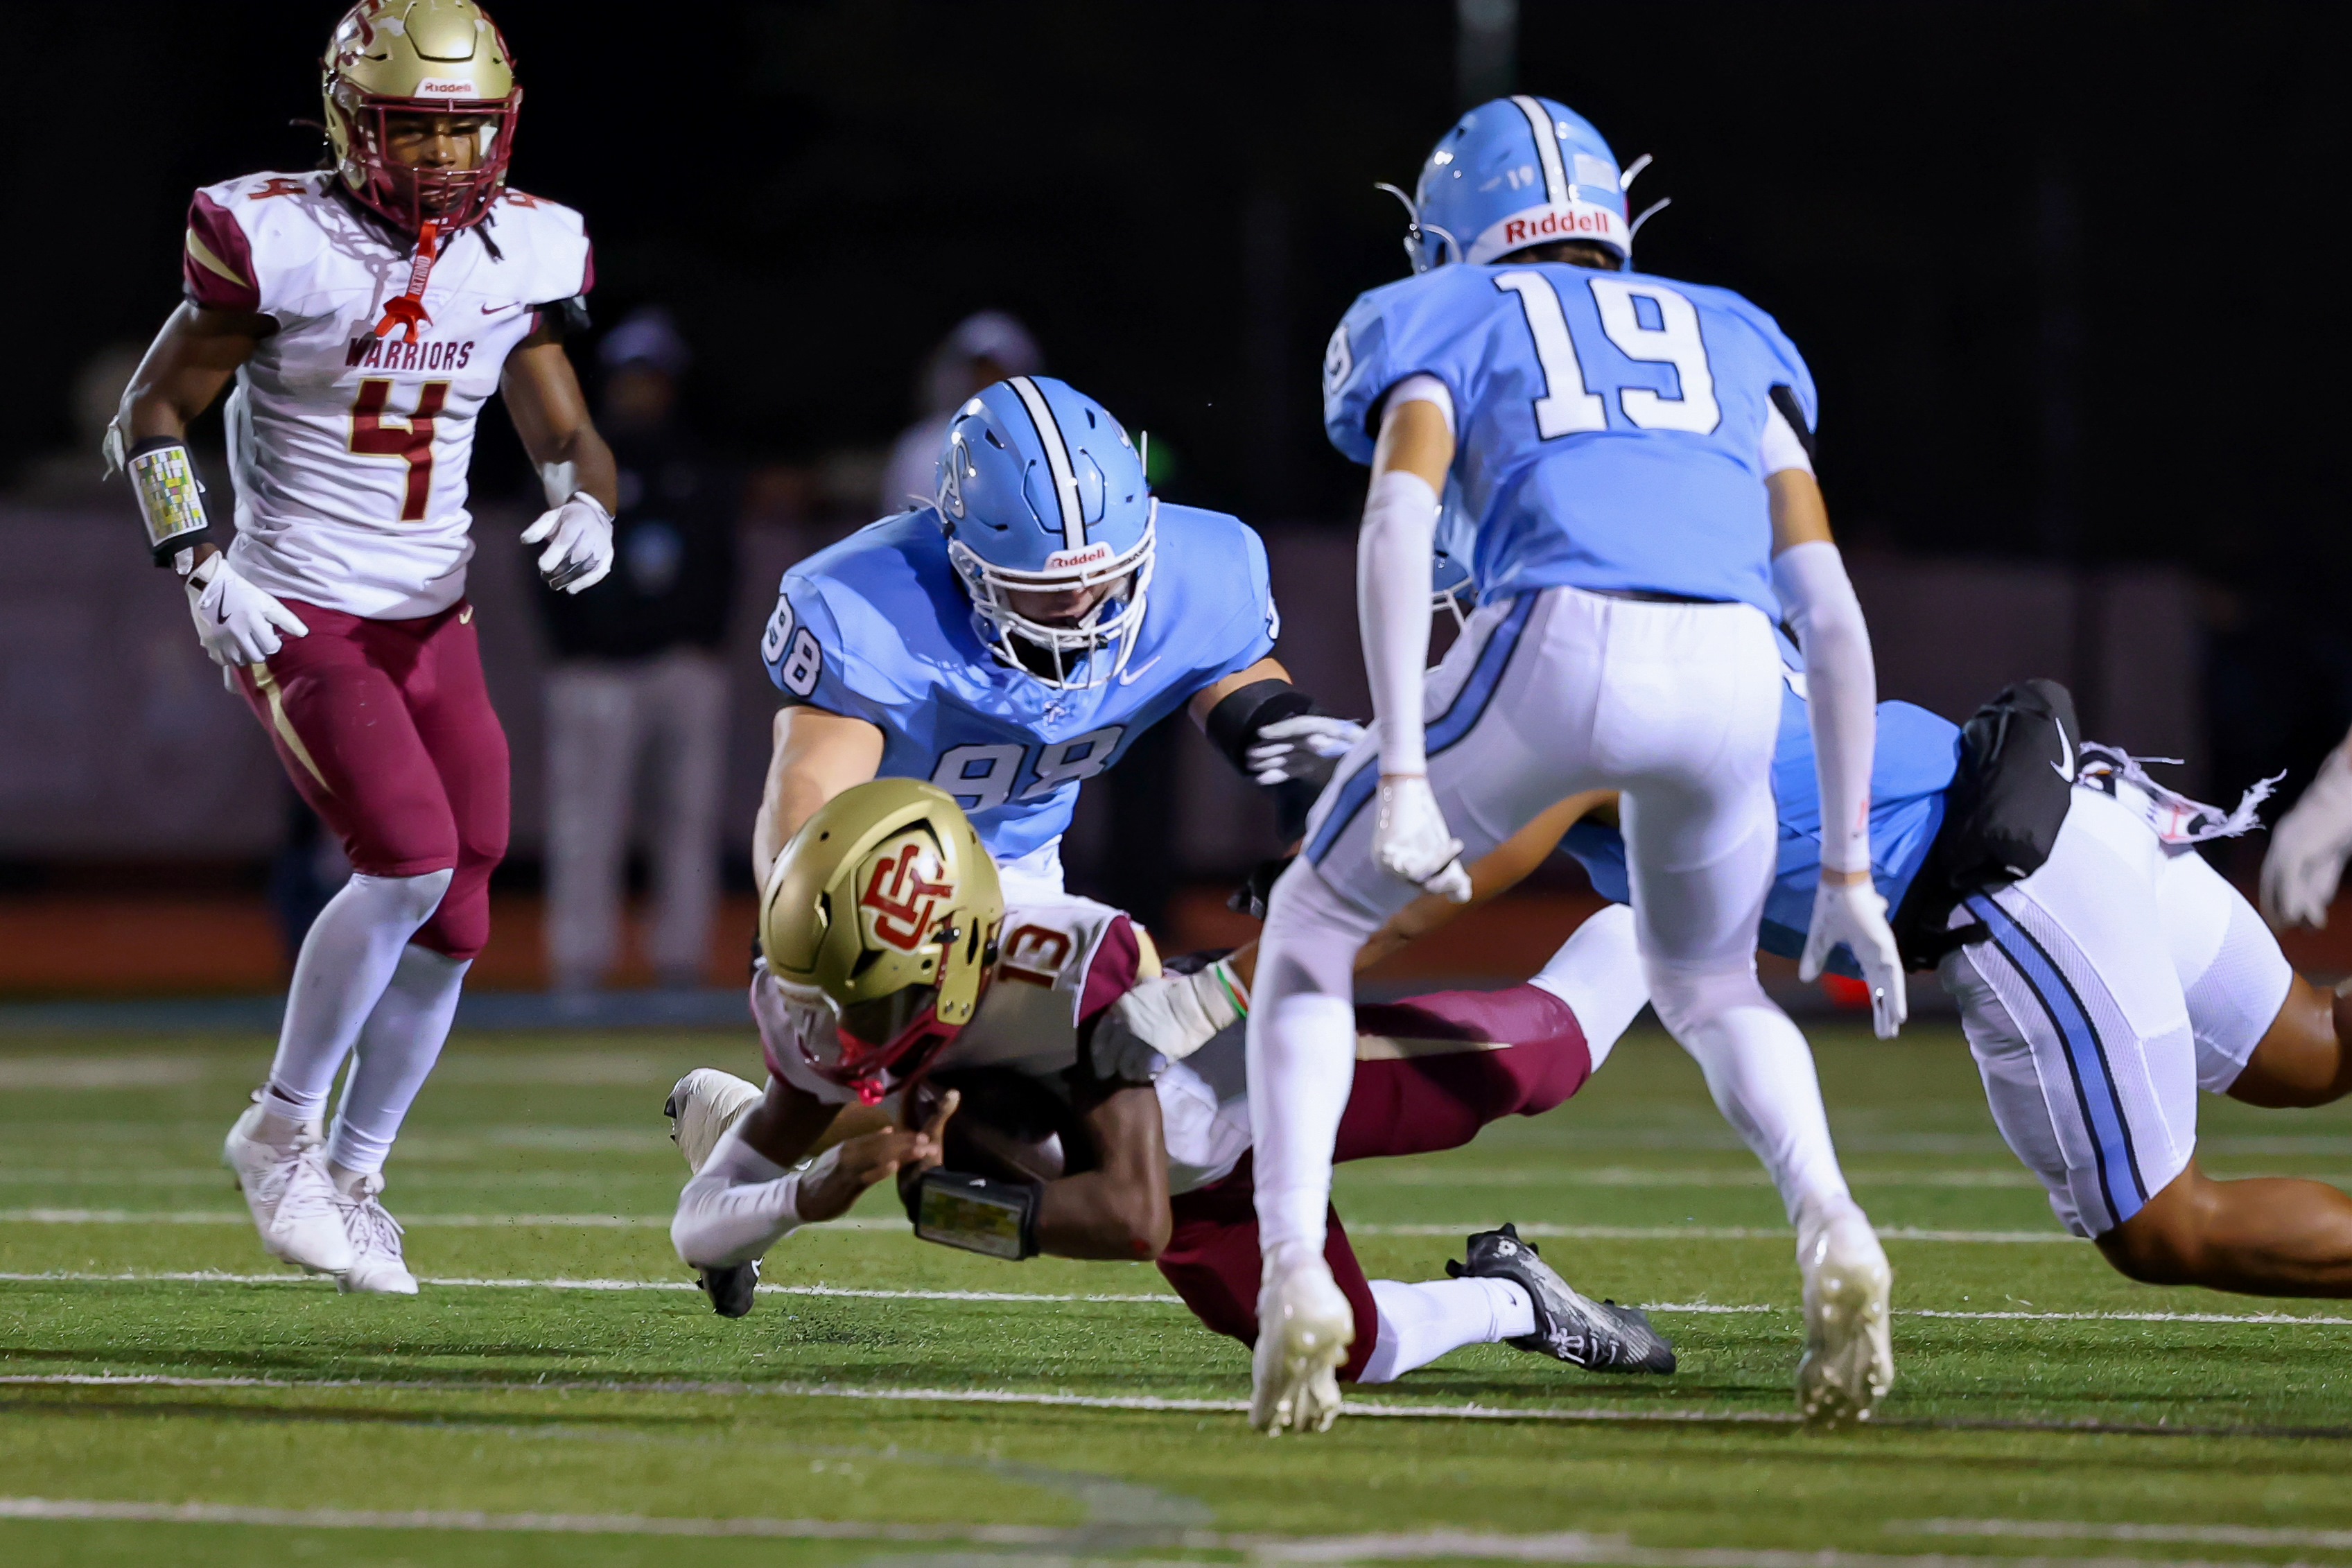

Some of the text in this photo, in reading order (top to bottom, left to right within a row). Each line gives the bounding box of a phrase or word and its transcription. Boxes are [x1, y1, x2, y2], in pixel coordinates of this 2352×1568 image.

[1506, 211, 1609, 244] Riddell
[345, 338, 475, 371] WARRIORS
[1493, 270, 1721, 442] 19
[349, 378, 452, 523] 4
[761, 593, 823, 697] 98
[998, 923, 1072, 991] 13
